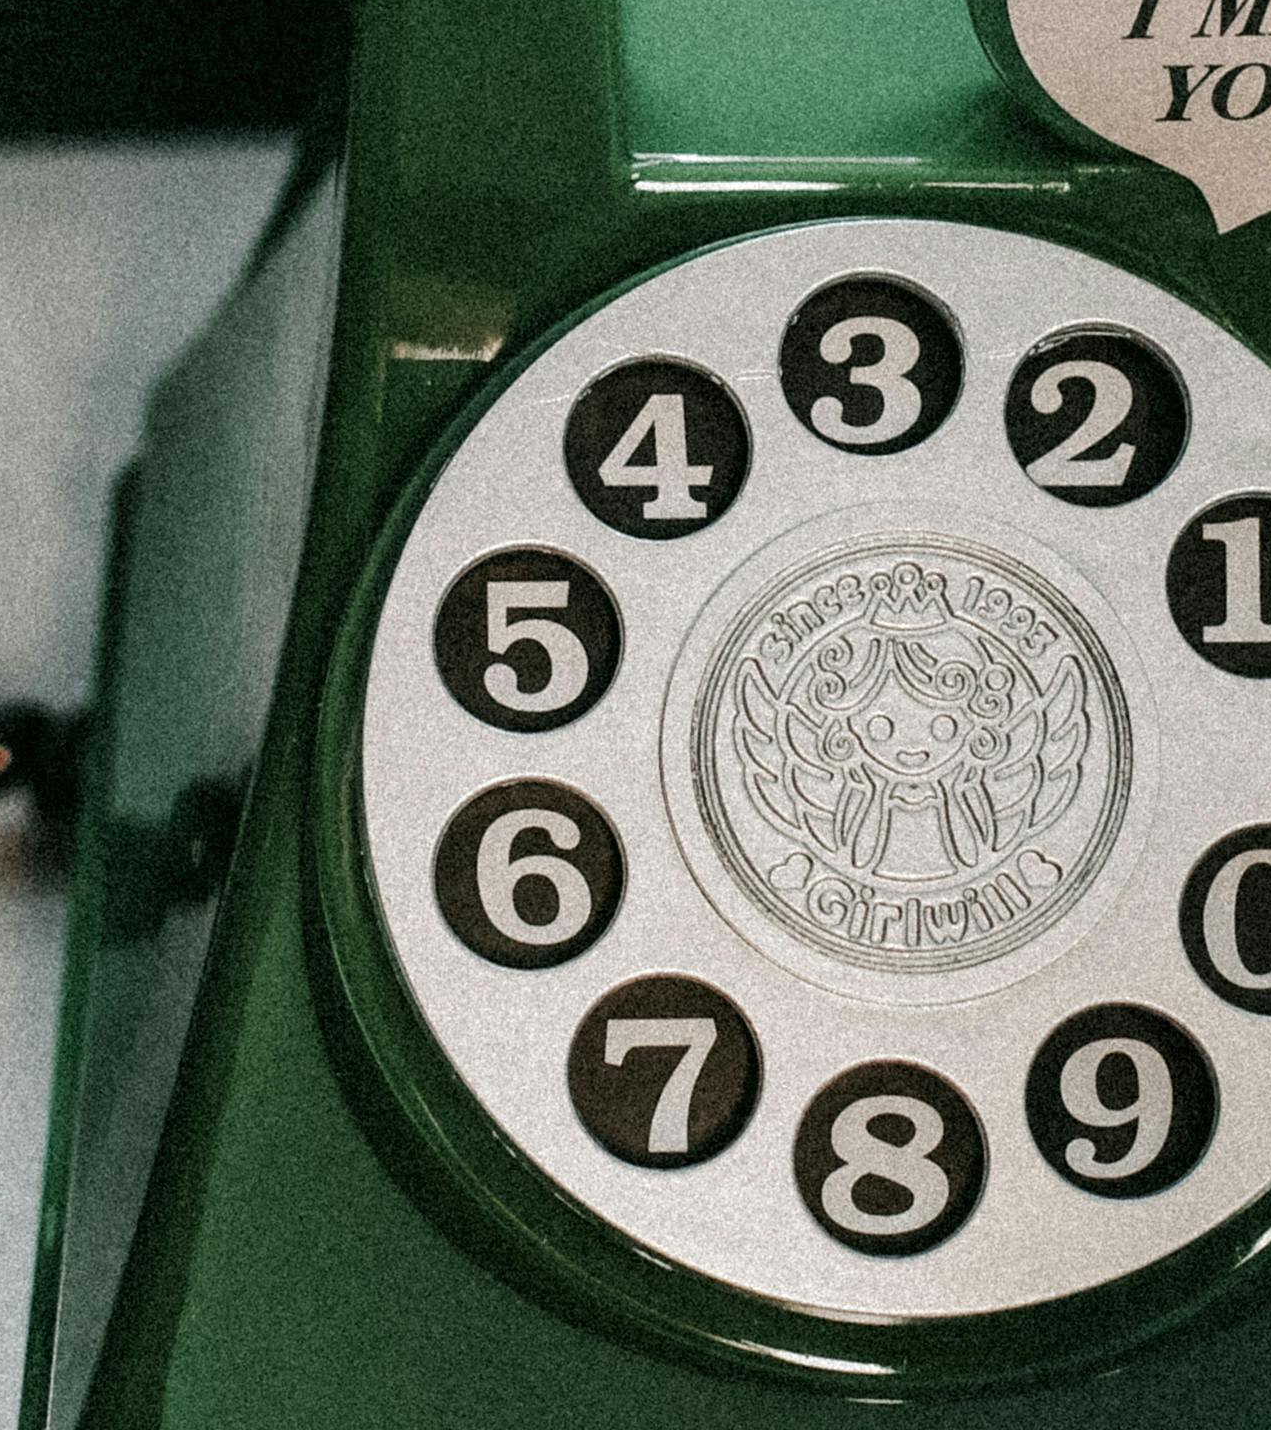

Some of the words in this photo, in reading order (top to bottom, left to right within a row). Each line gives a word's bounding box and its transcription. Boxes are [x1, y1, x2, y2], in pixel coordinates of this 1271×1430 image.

[809, 316, 923, 445] 3
[1027, 360, 1137, 487] 2
[597, 393, 714, 520] 4
[482, 580, 590, 712] 5
[759, 573, 866, 663] since
[475, 809, 593, 944] 6
[603, 1018, 718, 1154] 7
[1058, 1037, 1175, 1178] 9
[820, 1095, 951, 1235] 8
